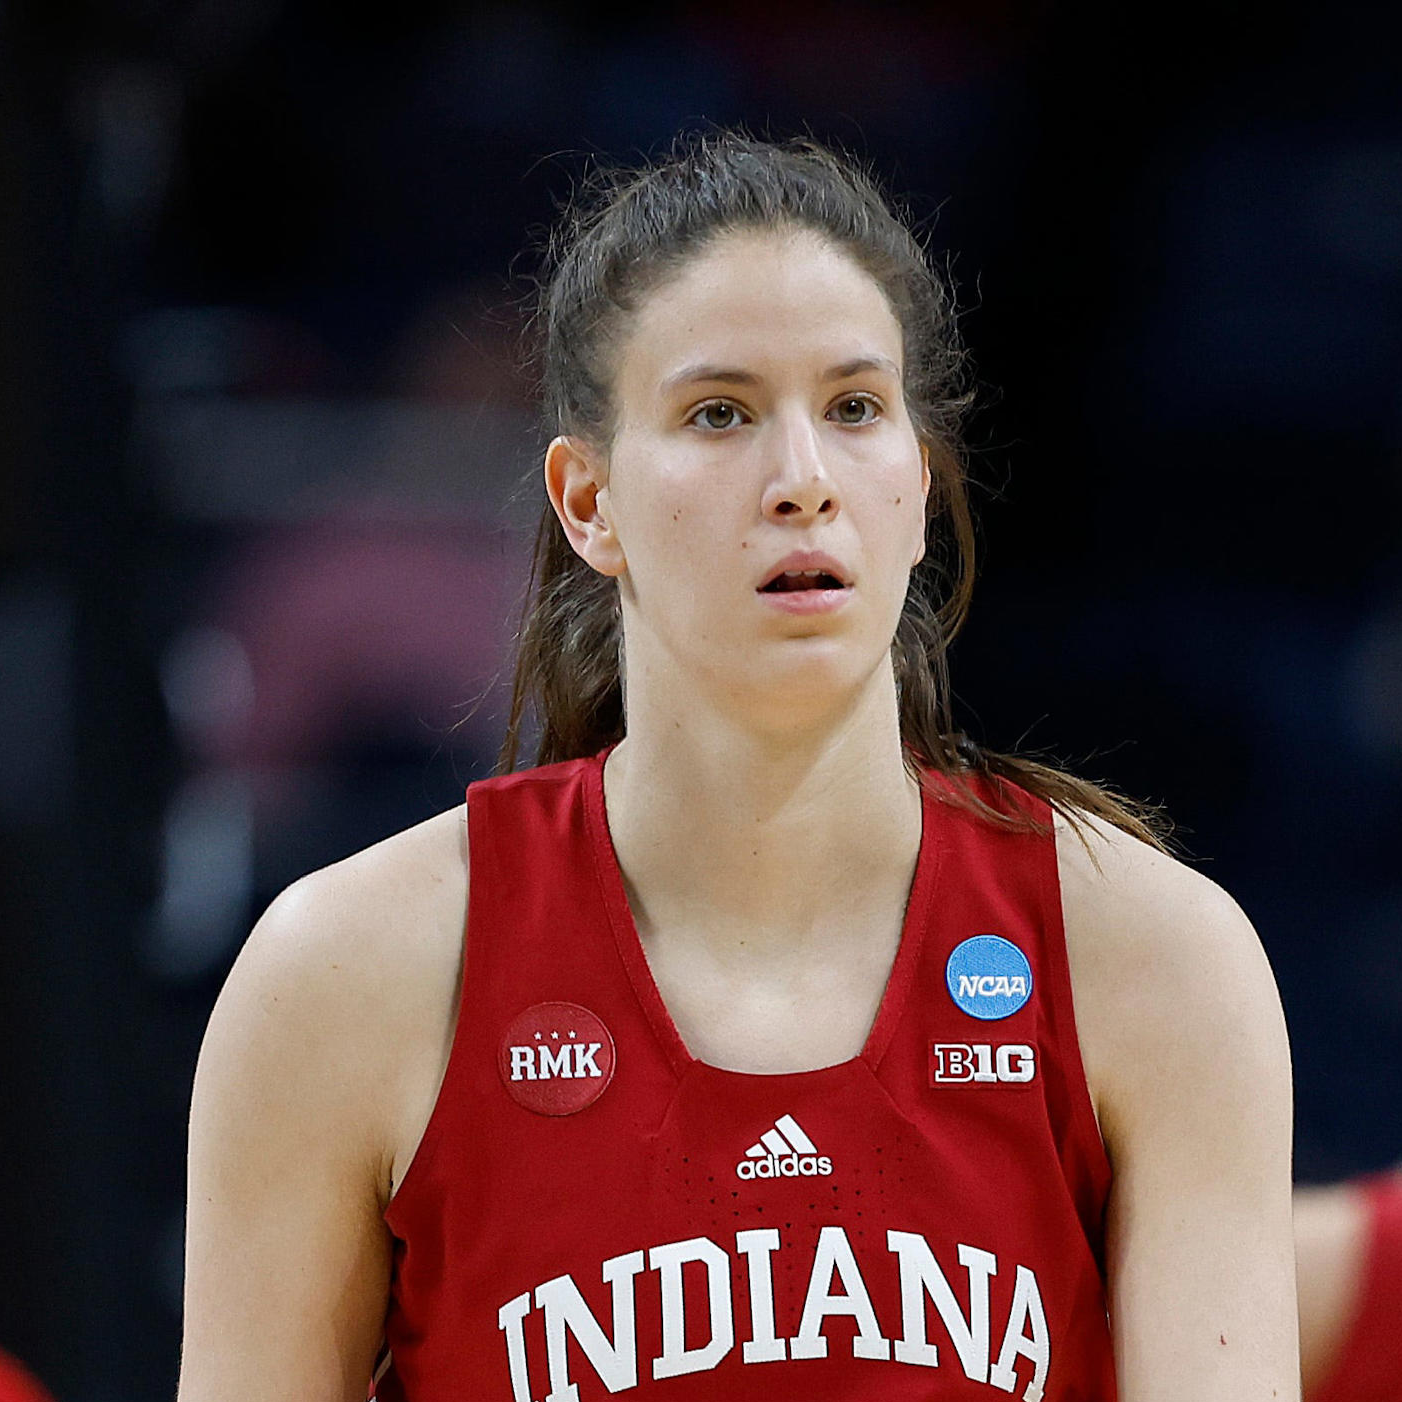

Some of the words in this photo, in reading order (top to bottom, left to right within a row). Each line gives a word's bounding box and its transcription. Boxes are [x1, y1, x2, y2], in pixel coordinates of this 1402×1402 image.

[958, 975, 1027, 998] NCAA
[509, 1042, 602, 1082] RMK
[736, 1152, 833, 1180] adidas
